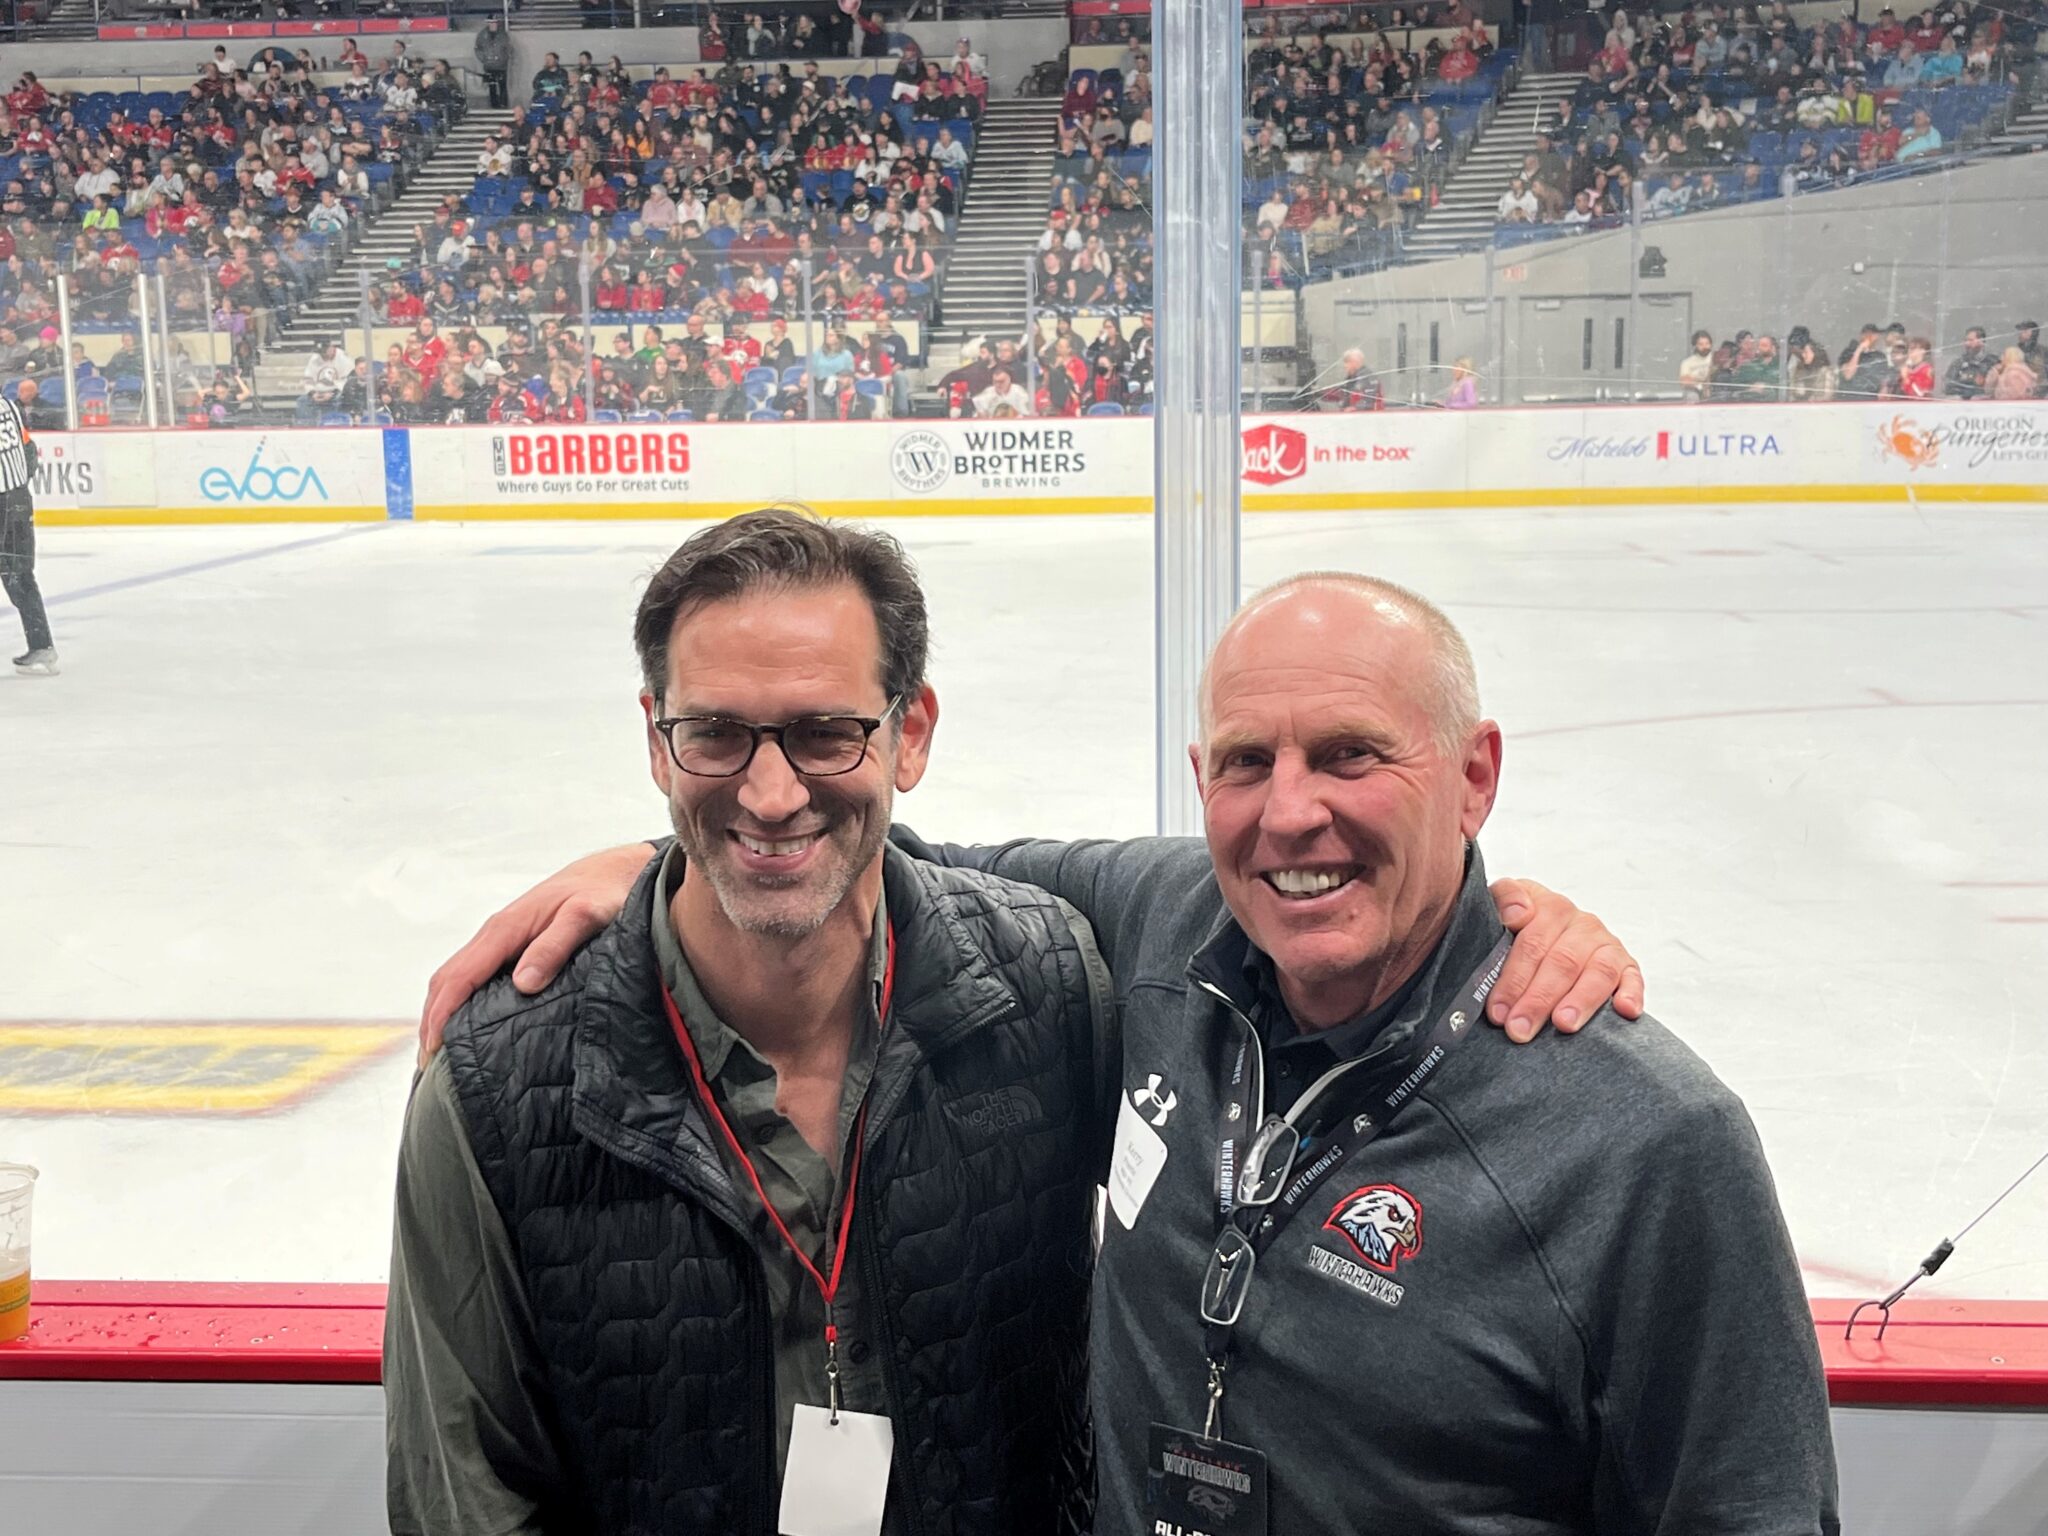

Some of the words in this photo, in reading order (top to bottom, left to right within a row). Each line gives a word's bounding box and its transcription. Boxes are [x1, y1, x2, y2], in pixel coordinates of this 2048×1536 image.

[1954, 415, 2035, 430] OREGON
[964, 431, 1073, 451] WIDMER
[1547, 436, 1649, 461] Michelob
[1678, 434, 1780, 456] ULTRA
[492, 436, 506, 475] THE
[955, 454, 1085, 475] BROTHERS
[1314, 446, 1330, 462] in
[1336, 446, 1367, 461] the
[1373, 445, 1410, 461] box
[497, 481, 539, 492] Where
[543, 481, 573, 494] Guys
[576, 481, 593, 492] Go
[596, 480, 618, 491] For
[622, 479, 657, 491] Great
[661, 479, 690, 491] Cuts
[982, 476, 1060, 488] BREWING
[1386, 1045, 1445, 1107] WINTERHAWKS
[1219, 1139, 1234, 1214] WINTERHAWKS
[1283, 1145, 1343, 1205] WINTERHAWKS
[1308, 1244, 1405, 1306] WINTERHAWKS
